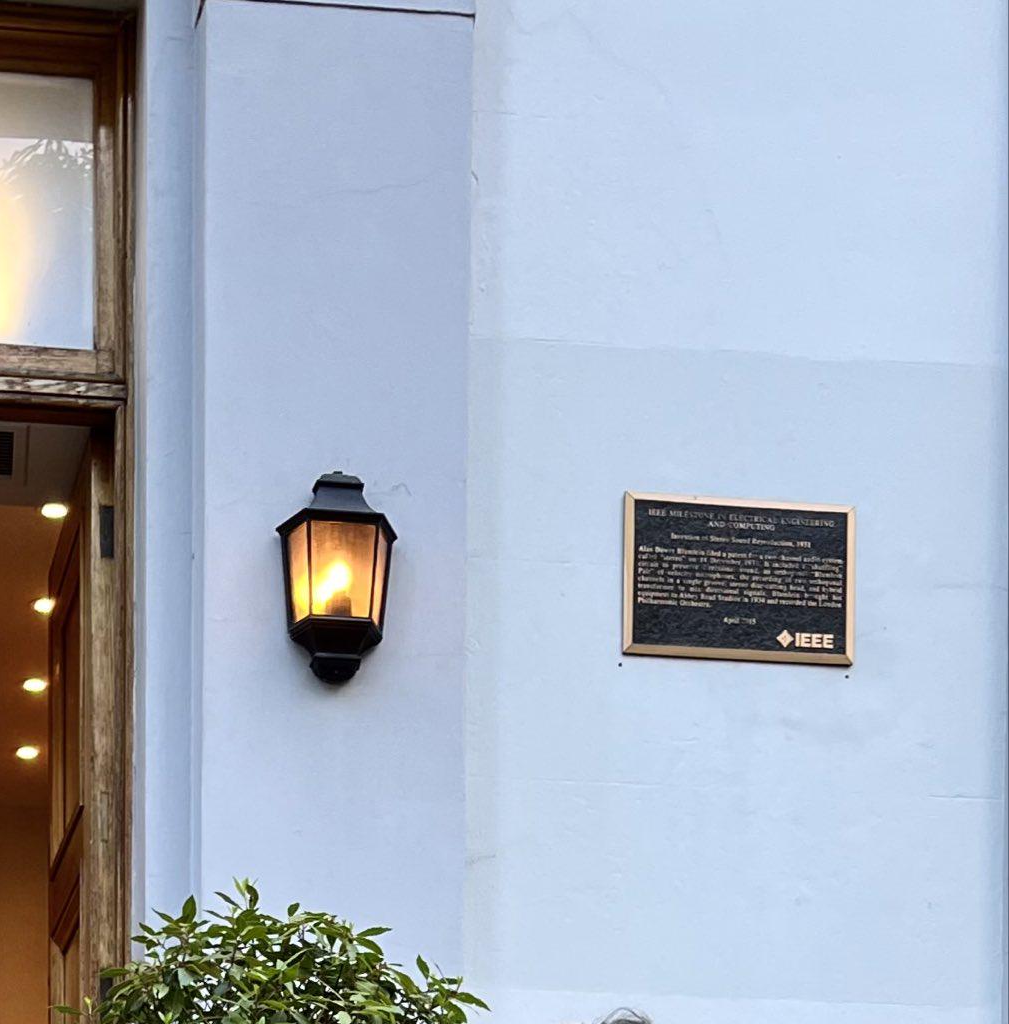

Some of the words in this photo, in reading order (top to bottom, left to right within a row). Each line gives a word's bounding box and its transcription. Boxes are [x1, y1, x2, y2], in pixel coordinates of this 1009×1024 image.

[648, 508, 666, 517] IEEE
[729, 513, 777, 524] ELECTRICAL
[781, 517, 835, 527] ENGINEERING
[707, 520, 726, 528] AND
[729, 521, 775, 531] COMPUTING
[795, 632, 834, 649] IEEE
